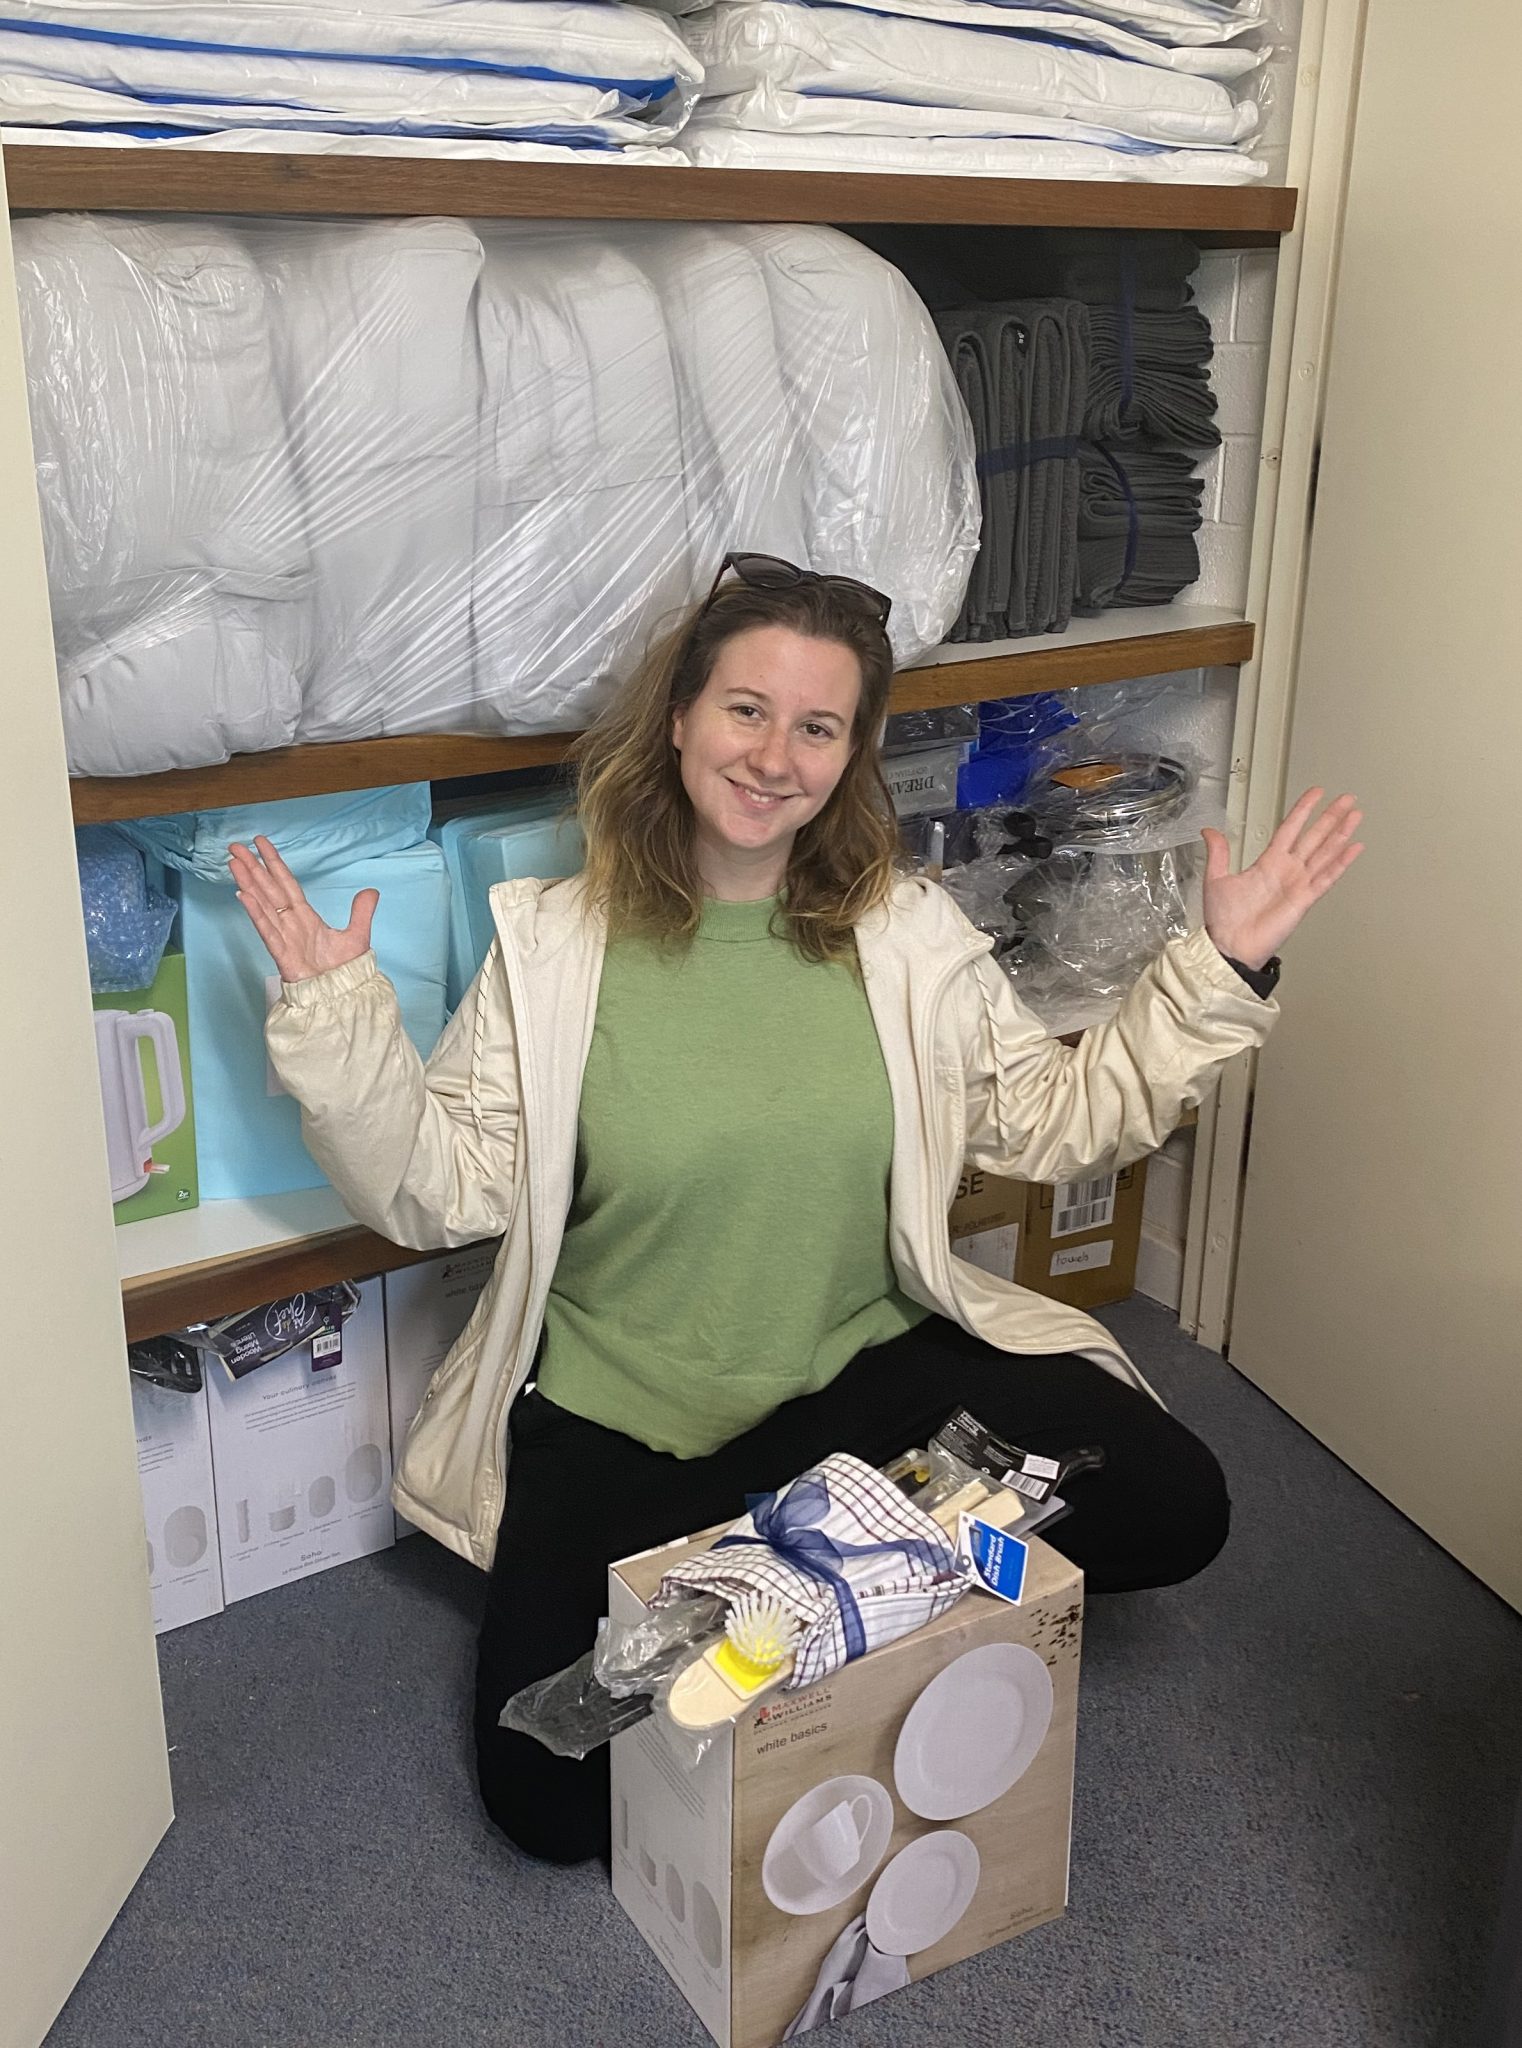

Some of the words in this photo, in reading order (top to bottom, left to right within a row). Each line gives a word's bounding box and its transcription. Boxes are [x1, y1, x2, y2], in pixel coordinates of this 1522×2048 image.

[230, 1347, 263, 1365] Wooden
[983, 1533, 997, 1580] Standard
[994, 1536, 1005, 1565] Brush
[991, 1564, 1001, 1587] Dish
[756, 1737, 788, 1755] white
[790, 1721, 829, 1743] basics
